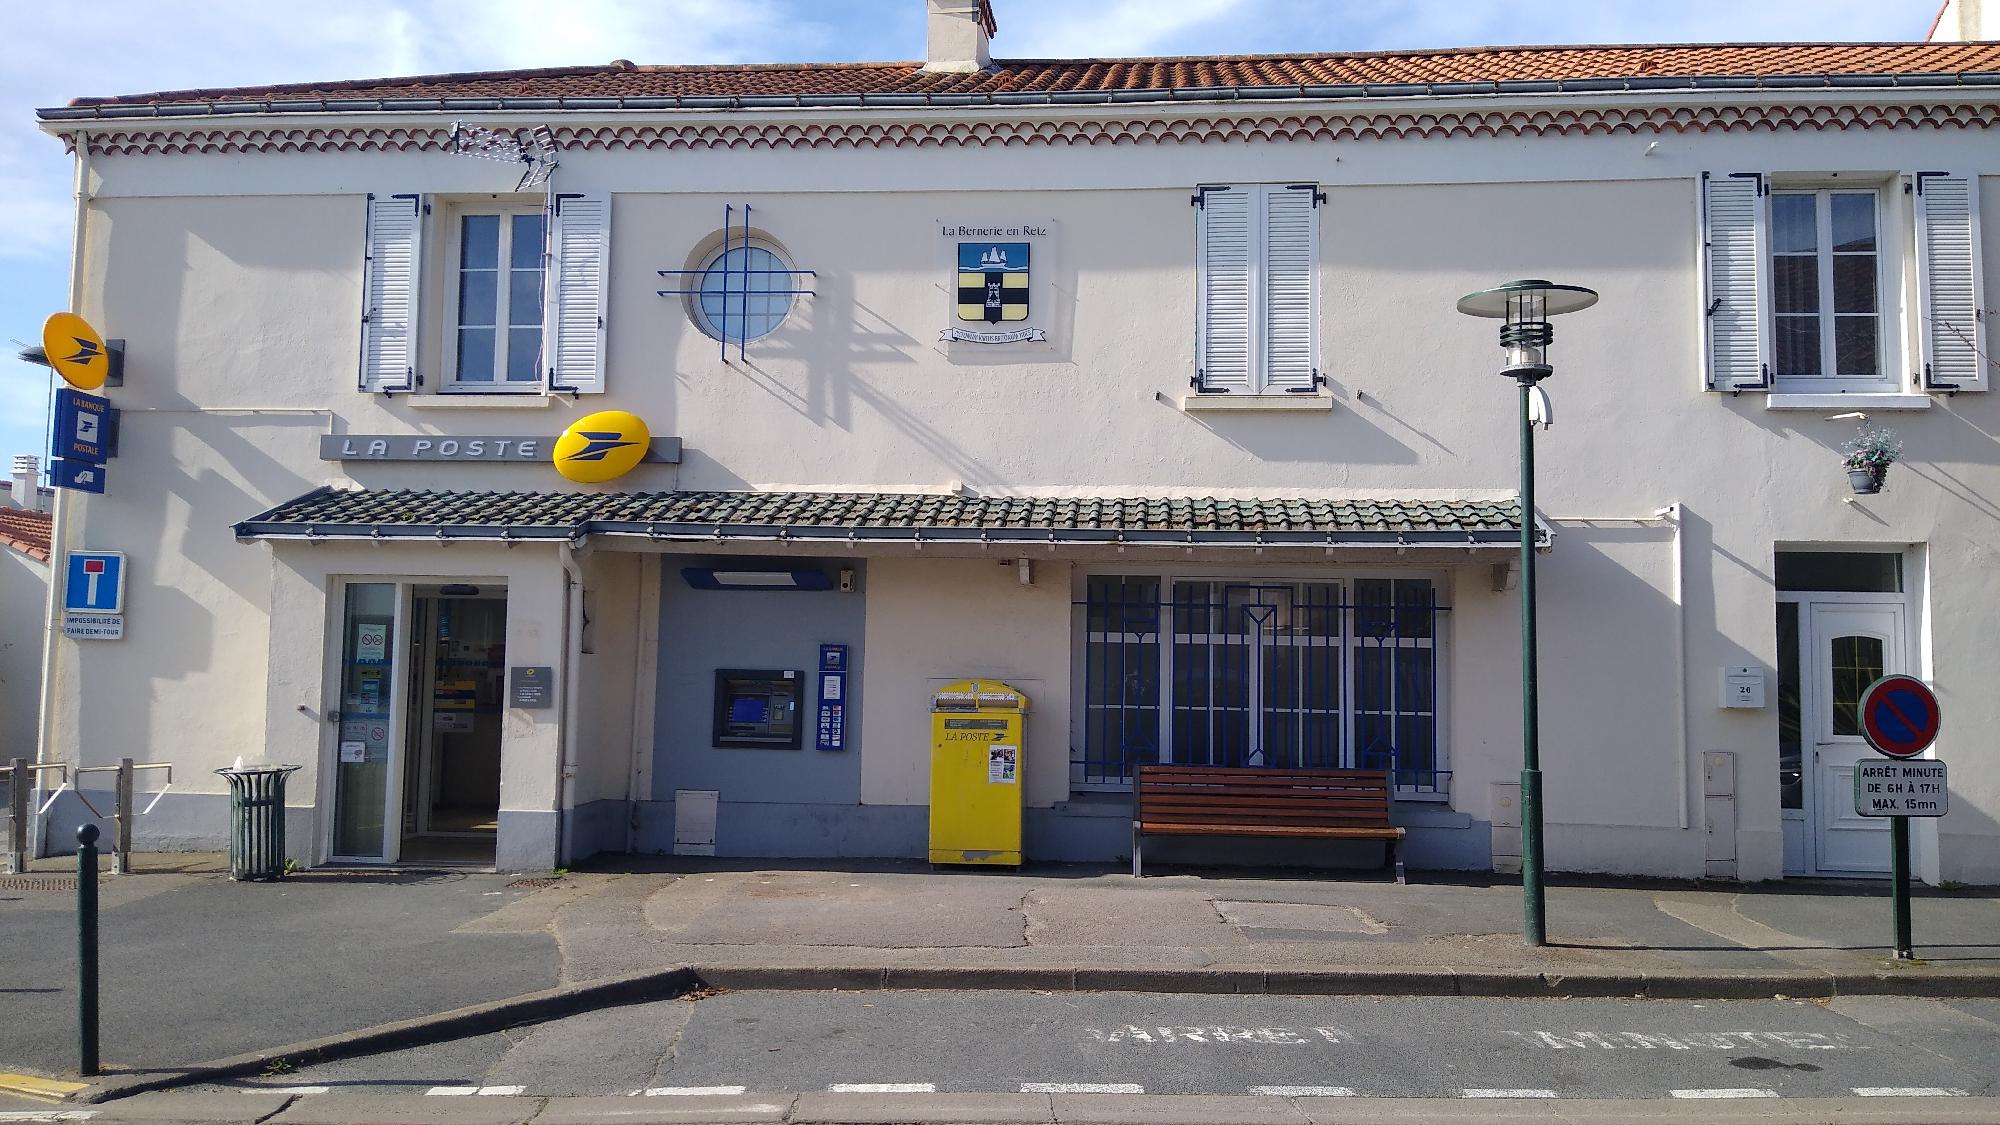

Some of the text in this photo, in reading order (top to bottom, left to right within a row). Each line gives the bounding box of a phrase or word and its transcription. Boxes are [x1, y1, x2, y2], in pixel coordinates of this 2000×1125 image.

[942, 226, 1047, 236] La Bernerie en Retz
[73, 398, 104, 413] LA BANQUE
[74, 443, 99, 455] POSTALE
[342, 439, 538, 457] LA POSTE
[66, 617, 111, 625] IMPOSSIBILITÉ
[66, 627, 119, 636] FAIRE DEMI-TOUR
[944, 732, 990, 742] LA POSTE
[1862, 765, 1944, 778] ARRÊT MINUTE
[1867, 780, 1940, 794] DE 6H À 17H
[1904, 798, 1937, 810] 15mn
